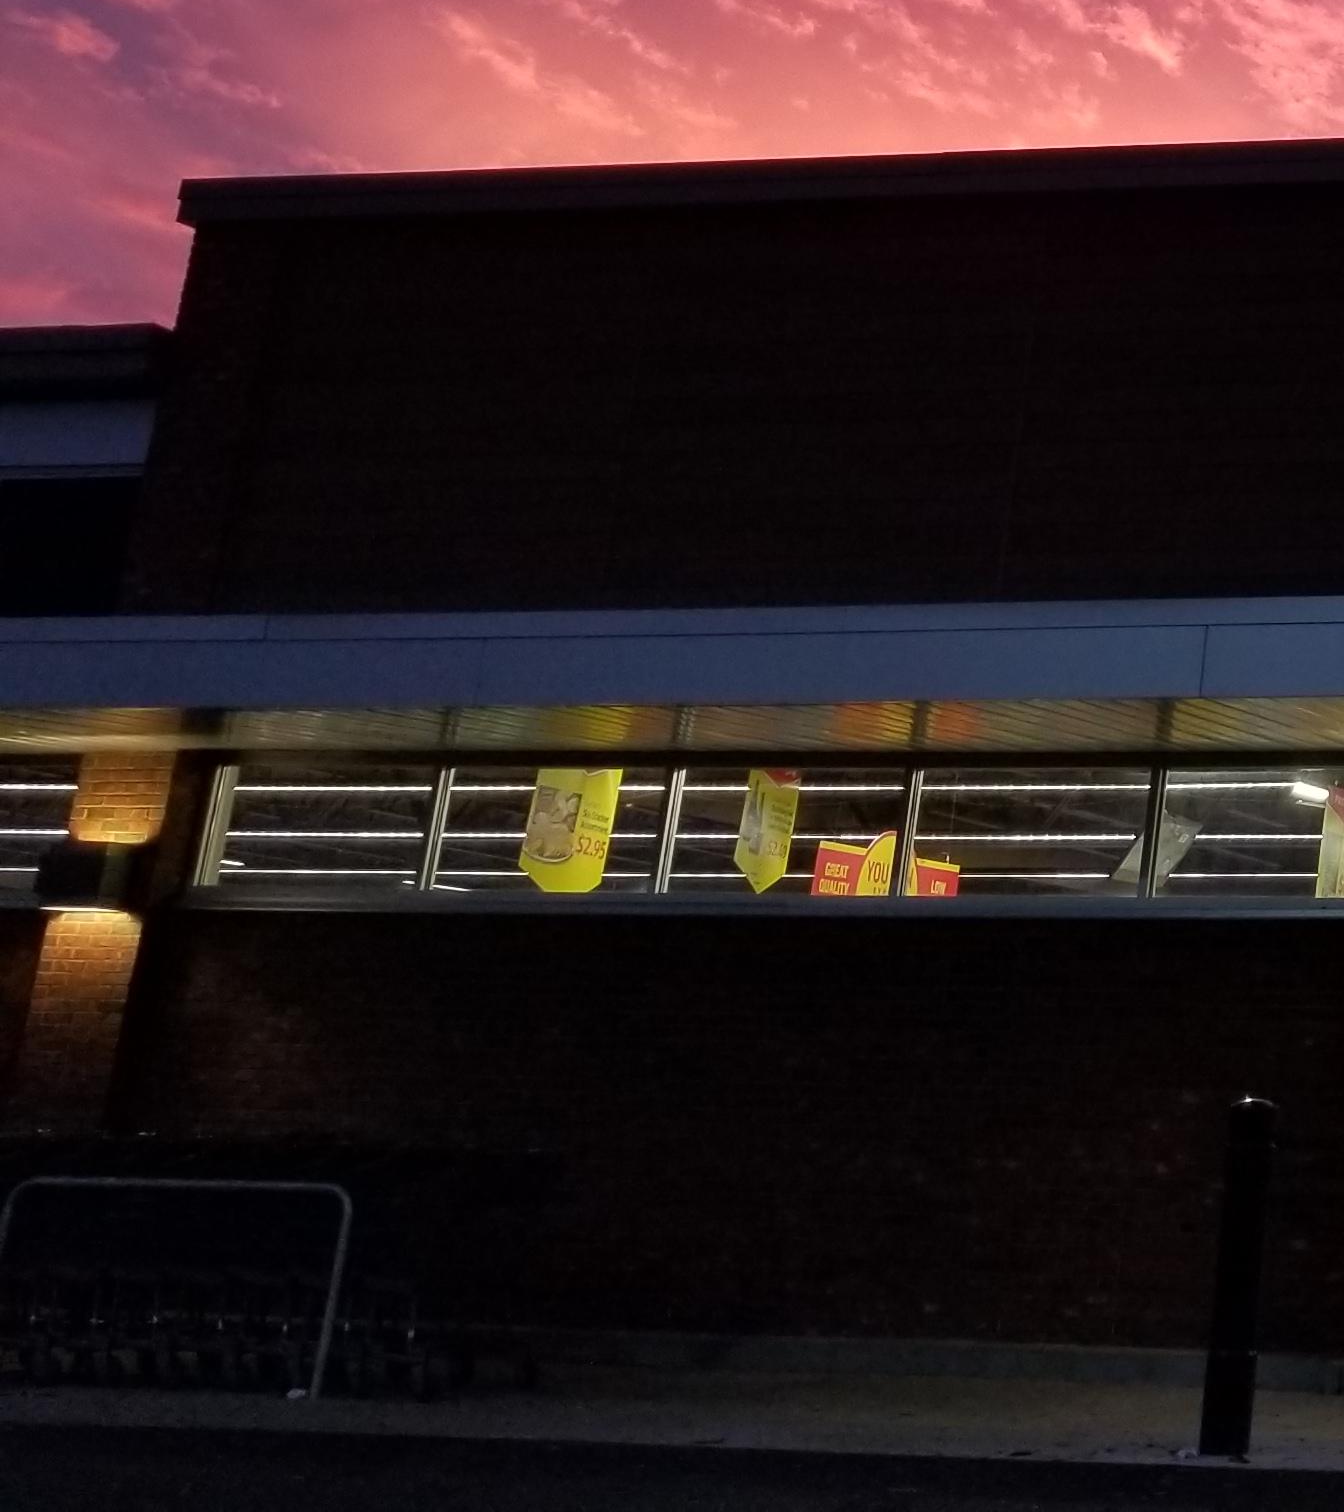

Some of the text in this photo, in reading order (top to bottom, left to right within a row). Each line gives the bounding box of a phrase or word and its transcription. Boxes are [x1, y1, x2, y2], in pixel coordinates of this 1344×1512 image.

[575, 833, 606, 860] $2.95
[824, 862, 849, 879] GREAT
[868, 860, 890, 884] YOU
[930, 880, 947, 895] LOW
